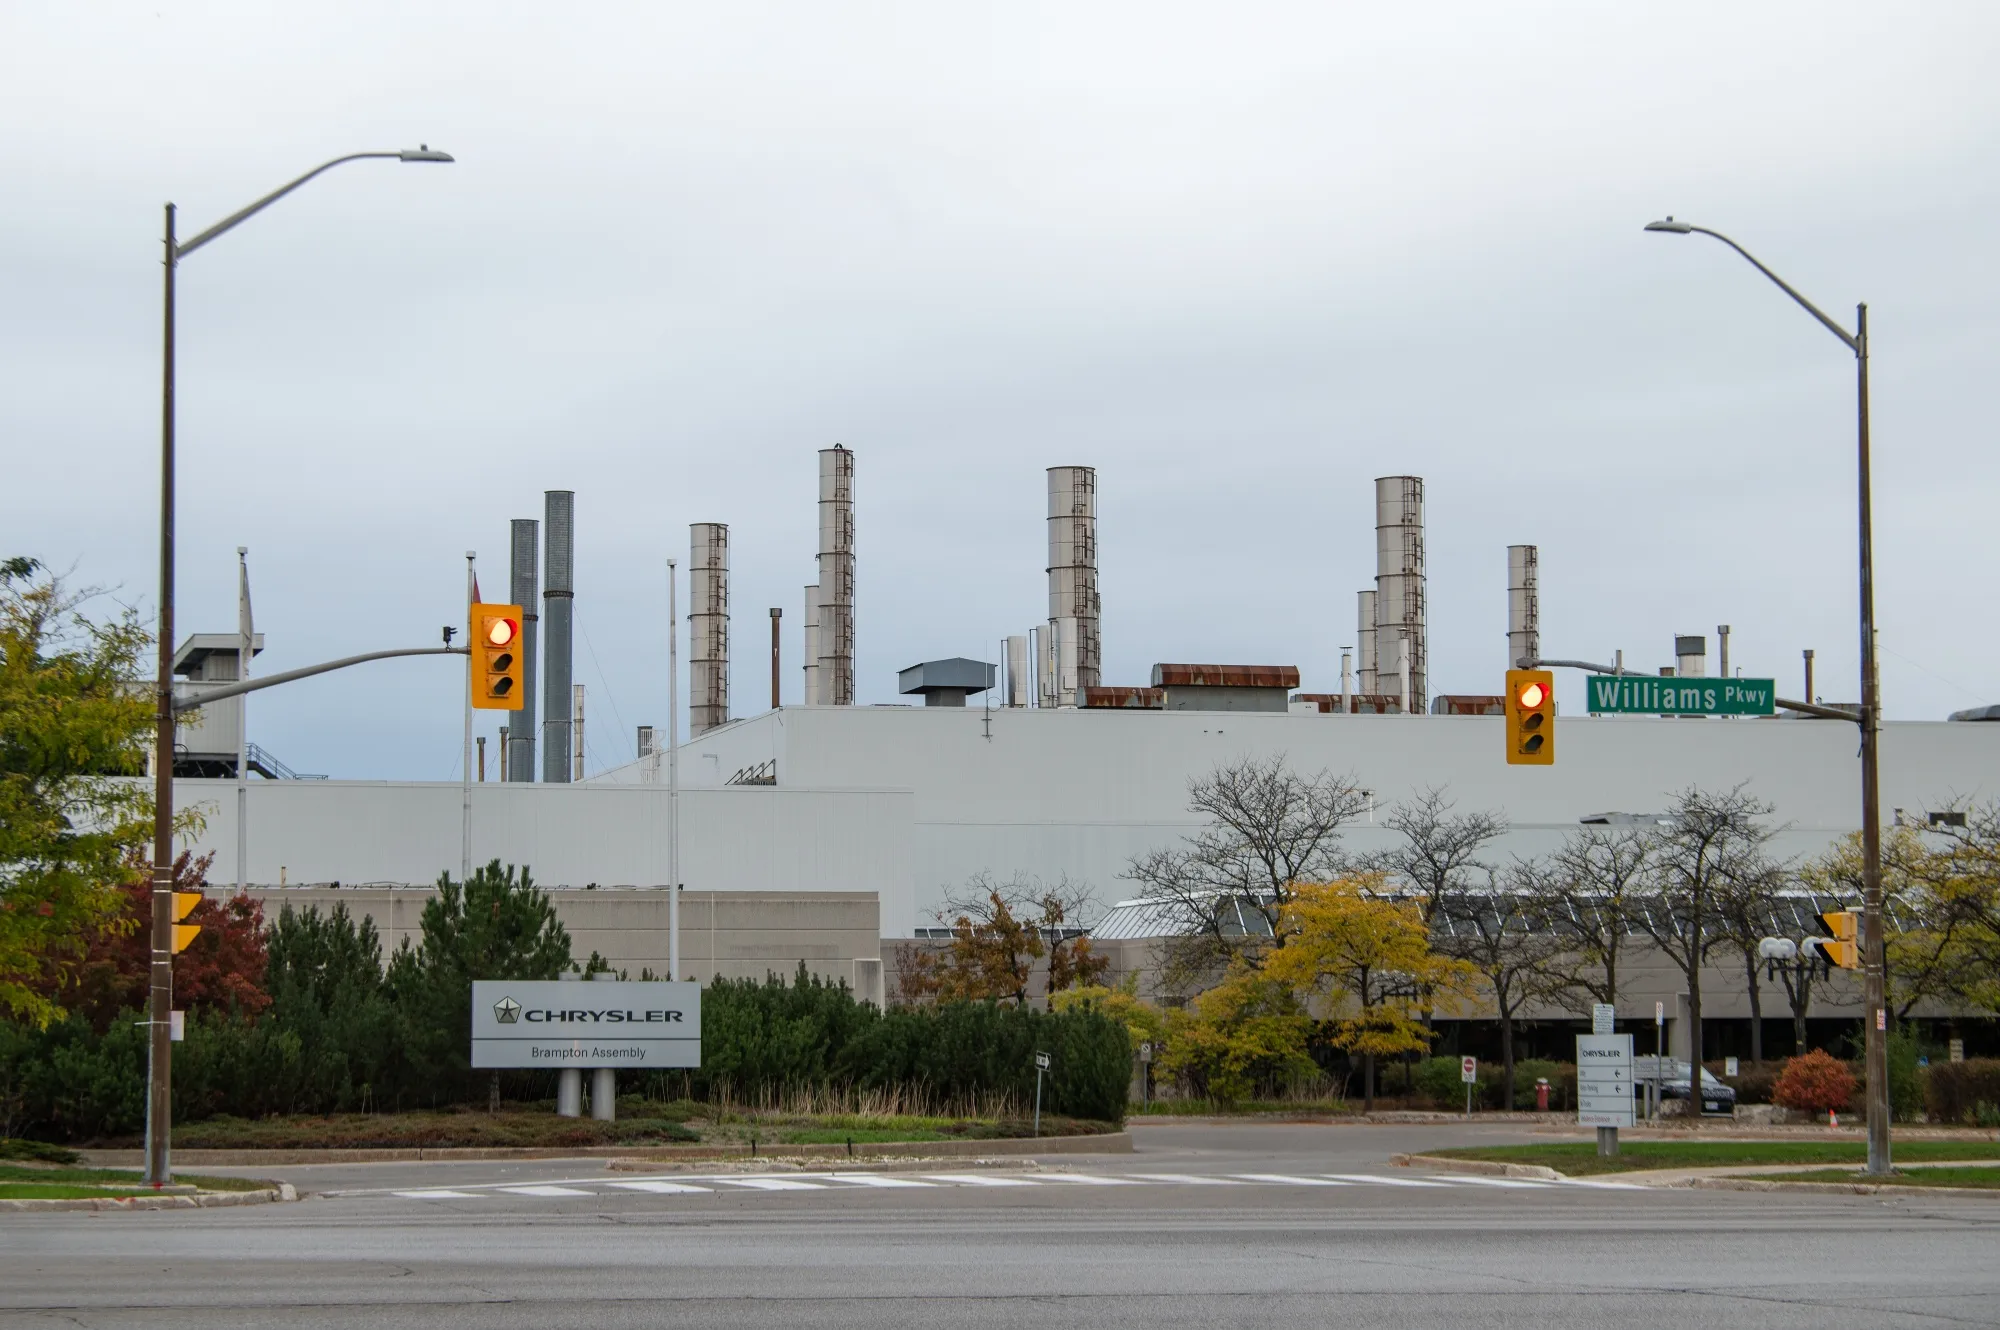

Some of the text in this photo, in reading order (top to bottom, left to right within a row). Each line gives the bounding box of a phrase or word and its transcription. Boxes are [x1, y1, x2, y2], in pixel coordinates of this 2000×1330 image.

[1596, 681, 1766, 710] Williams Pkwy
[524, 1010, 683, 1023] CHRYSLER
[532, 1046, 646, 1060] Brampton Assembly
